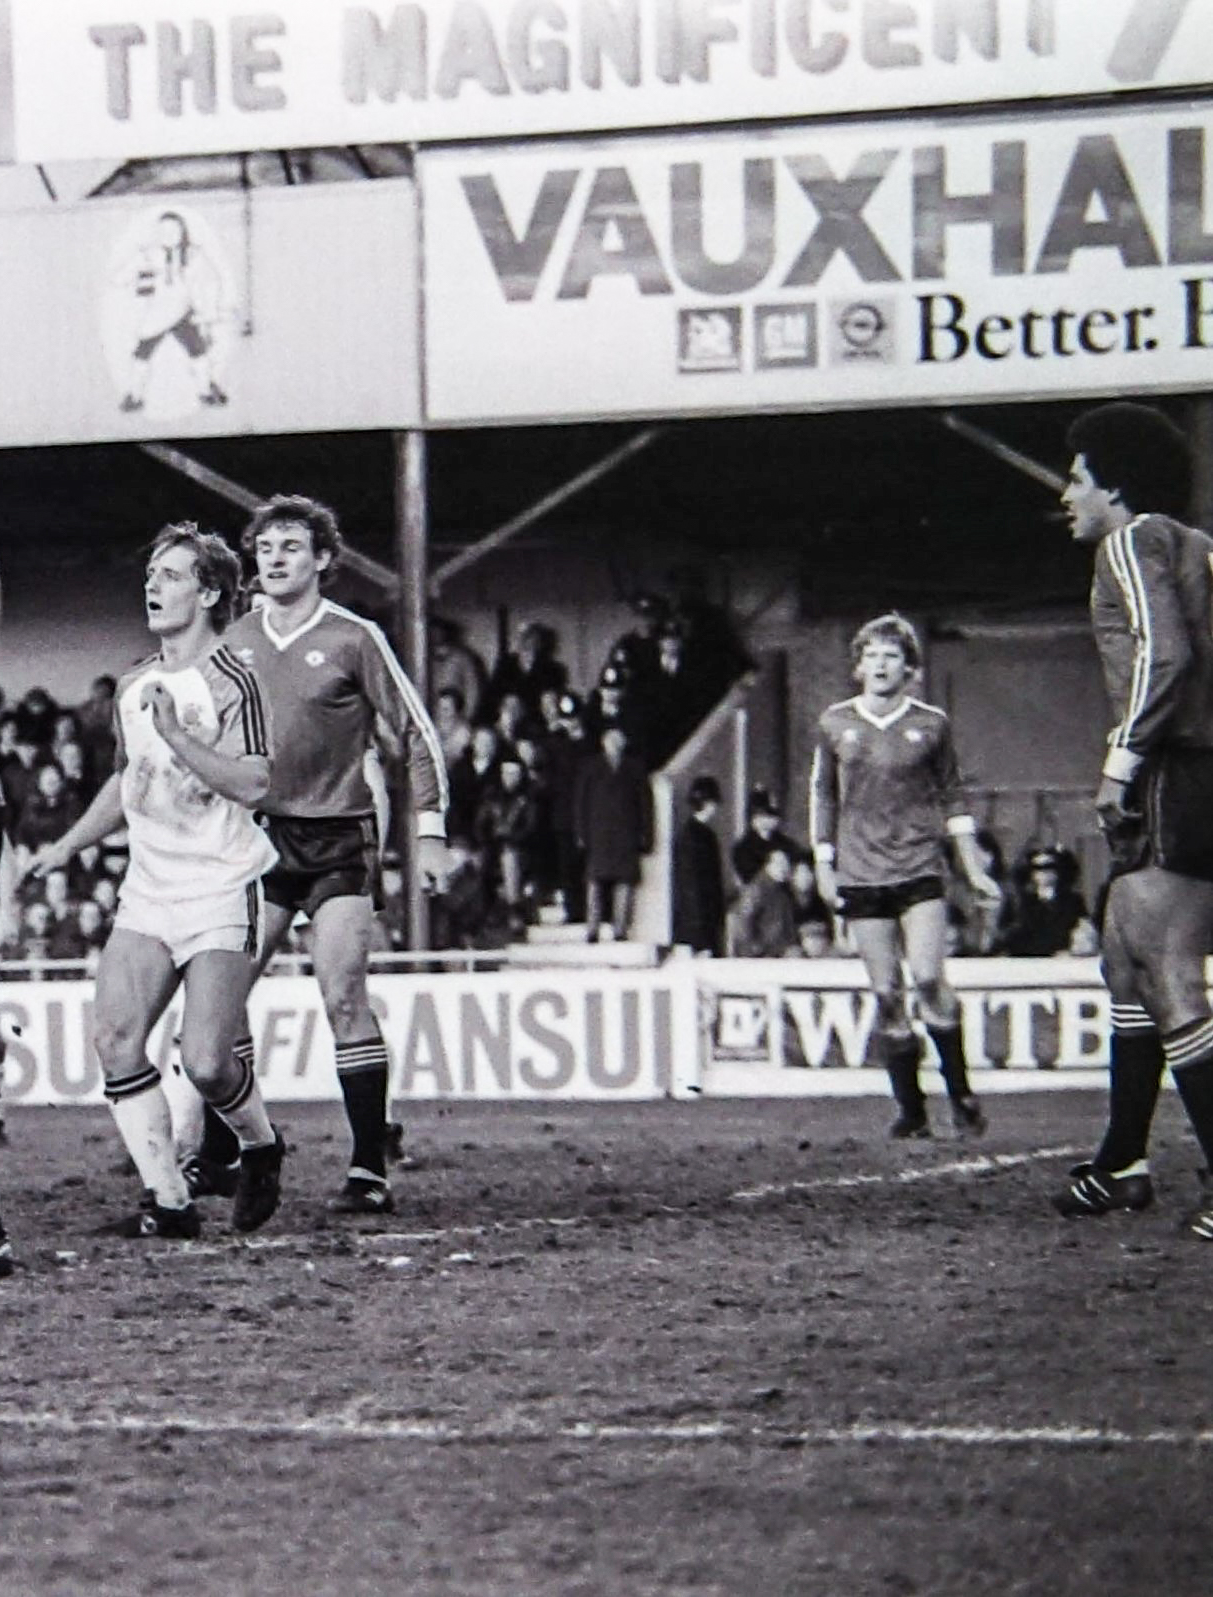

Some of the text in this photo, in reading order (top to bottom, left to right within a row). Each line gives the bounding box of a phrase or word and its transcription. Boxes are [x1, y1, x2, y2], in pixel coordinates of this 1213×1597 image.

[88, 14, 287, 120] THE
[914, 292, 1159, 364] Better.
[373, 989, 672, 1093] ANSUI
[785, 990, 1112, 1067] WITB
